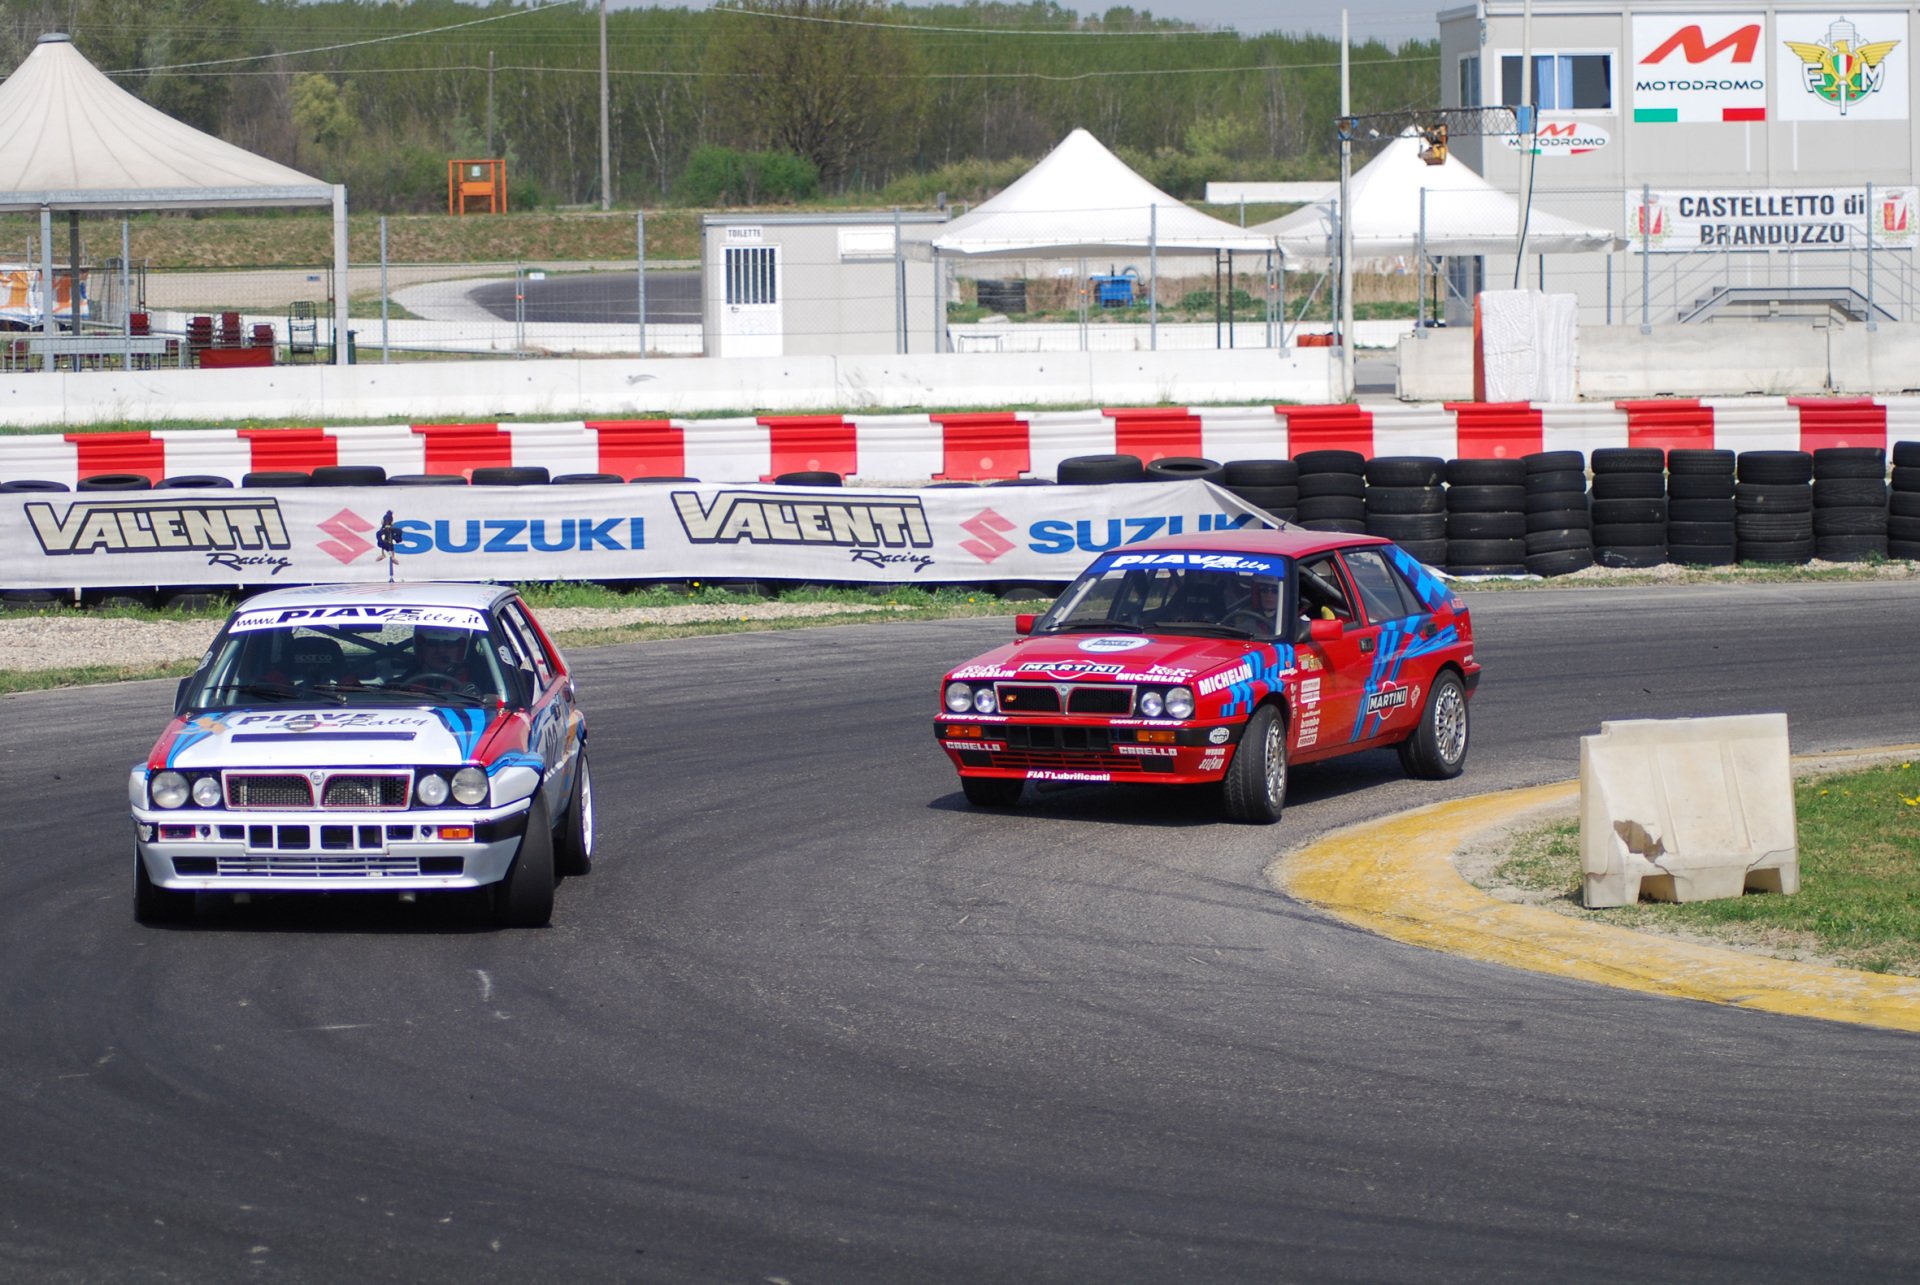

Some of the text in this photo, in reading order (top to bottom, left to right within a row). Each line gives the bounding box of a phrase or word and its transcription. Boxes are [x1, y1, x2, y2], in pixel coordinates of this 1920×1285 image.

[1635, 80, 1764, 91] MOTODROMO
[1508, 138, 1606, 146] MTODROMO
[1679, 194, 1865, 217] CASTELLETTO di
[728, 229, 761, 238] TOILETTE
[1700, 223, 1844, 245] BRANDUZZO
[24, 497, 291, 556] VALENTI
[670, 490, 933, 548] VALENTI
[392, 516, 645, 555] SUZUKI
[206, 553, 293, 575] Racing
[849, 549, 935, 572] Racing
[1109, 554, 1243, 568] PIAVE
[276, 608, 424, 623] PIAVE
[382, 612, 458, 623] Rally
[952, 670, 1016, 679] MICHELIN
[1021, 664, 1120, 673] MARTINI
[1115, 672, 1185, 683] MICHELIN
[1198, 663, 1253, 696] MICHELIN
[1369, 687, 1406, 711] MARTINI
[237, 713, 429, 728] PIAVE Rally
[946, 742, 1001, 752] CARELLO
[1118, 746, 1177, 756] CARELLO
